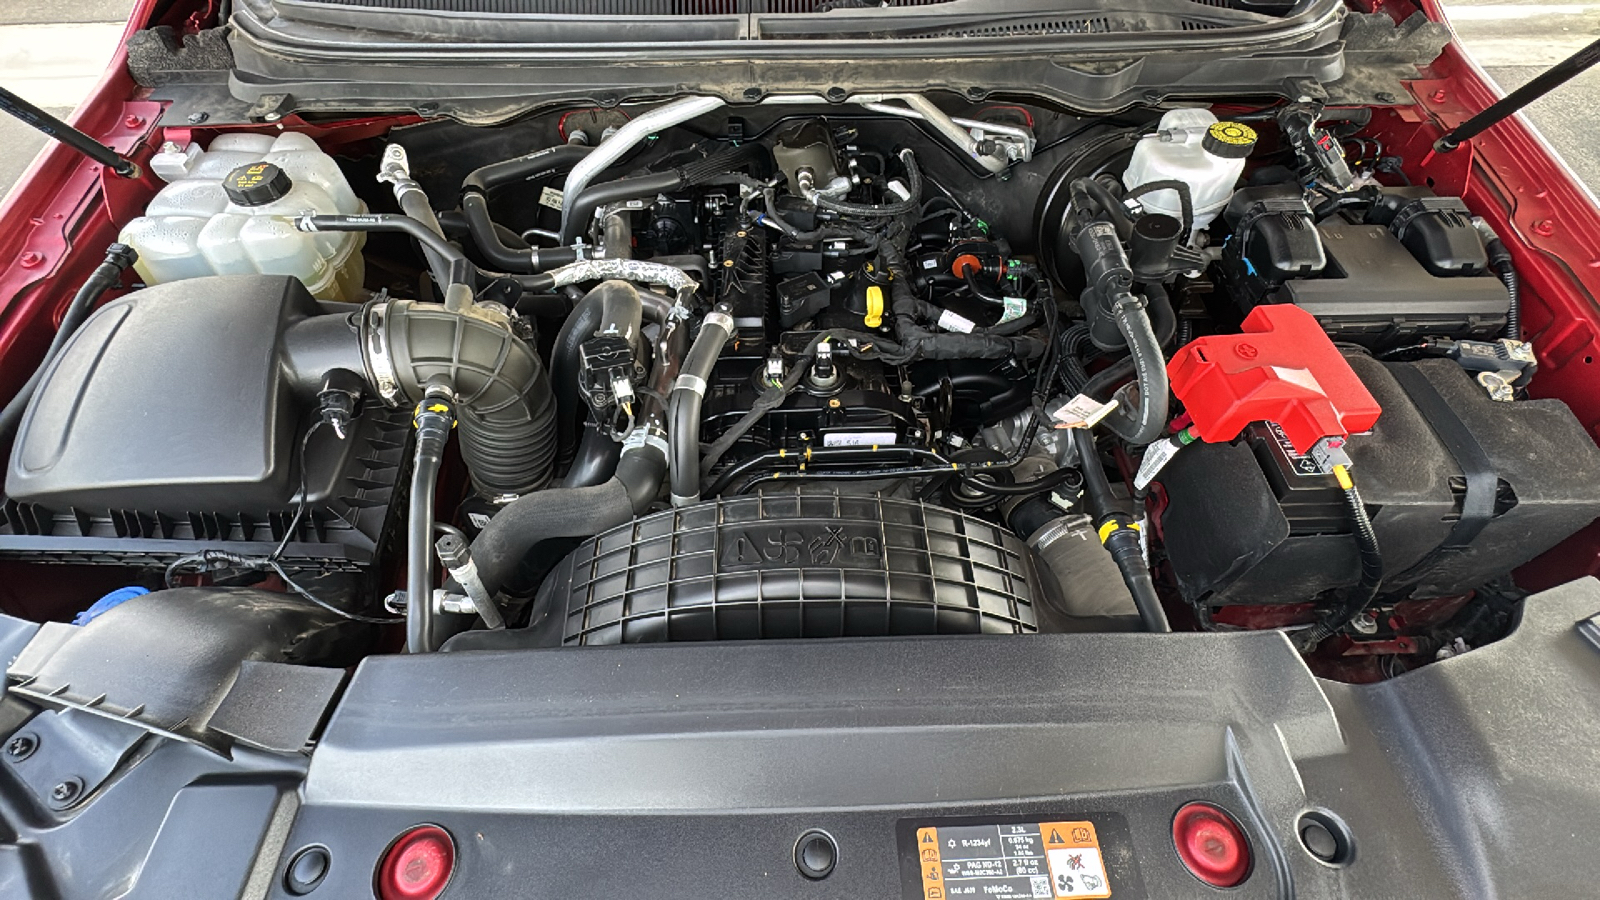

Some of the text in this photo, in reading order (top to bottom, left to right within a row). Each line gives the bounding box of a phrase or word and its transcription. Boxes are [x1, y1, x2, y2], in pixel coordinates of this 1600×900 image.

[961, 838, 991, 847] R-1234yf
[1012, 859, 1022, 867] 2.7
[983, 885, 1013, 893] FoMoCo
